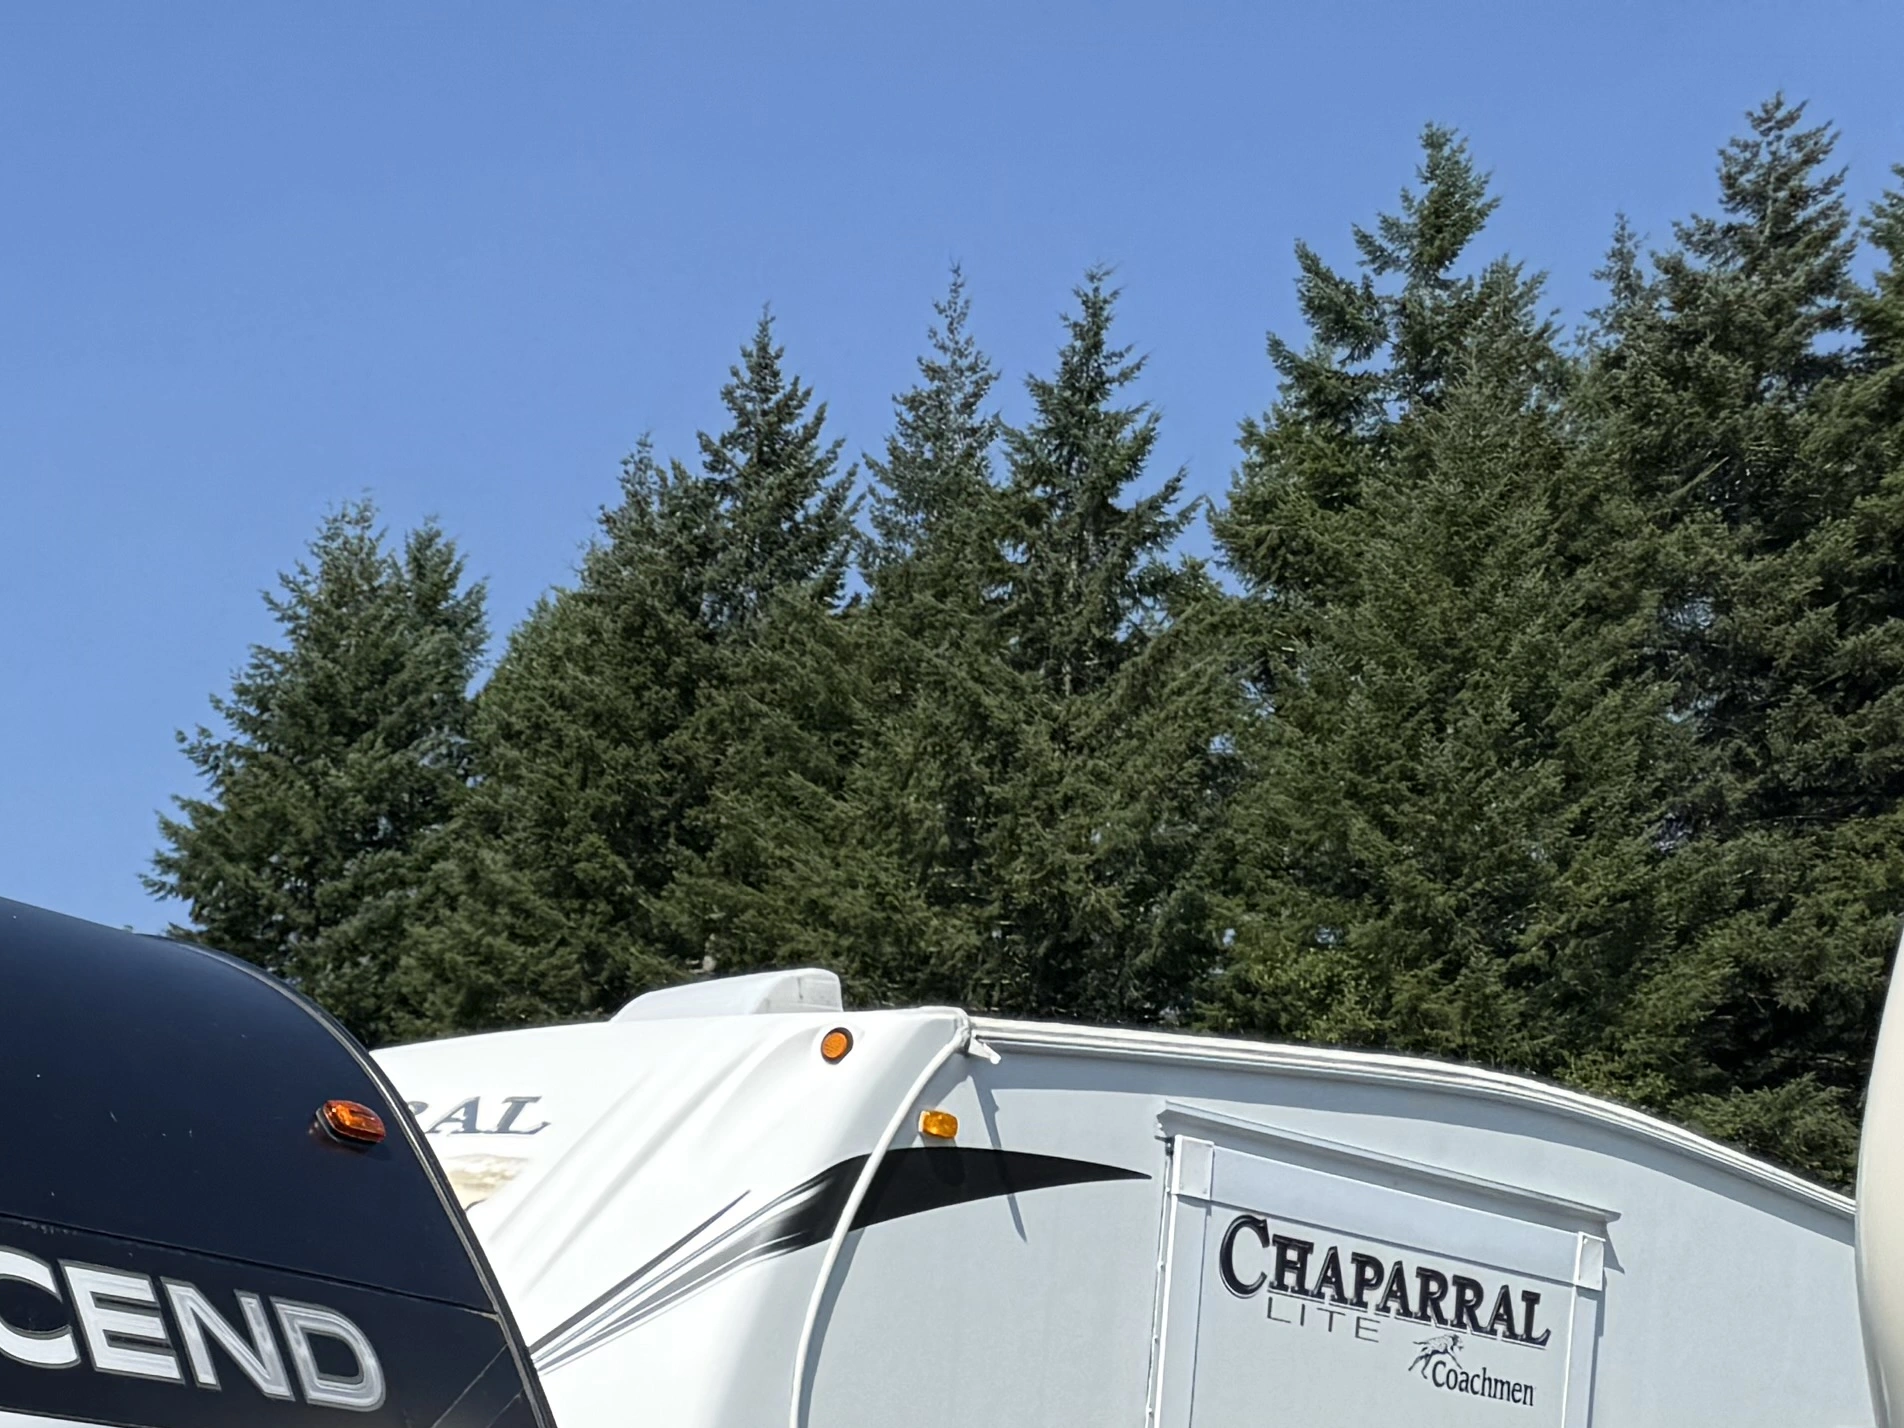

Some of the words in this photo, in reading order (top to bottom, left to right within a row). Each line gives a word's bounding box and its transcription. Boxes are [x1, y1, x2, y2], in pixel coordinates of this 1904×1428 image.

[1219, 1213, 1552, 1350] CHAPARRAL
[1266, 1296, 1382, 1344] LITE
[1431, 1360, 1535, 1407] Coachmen
